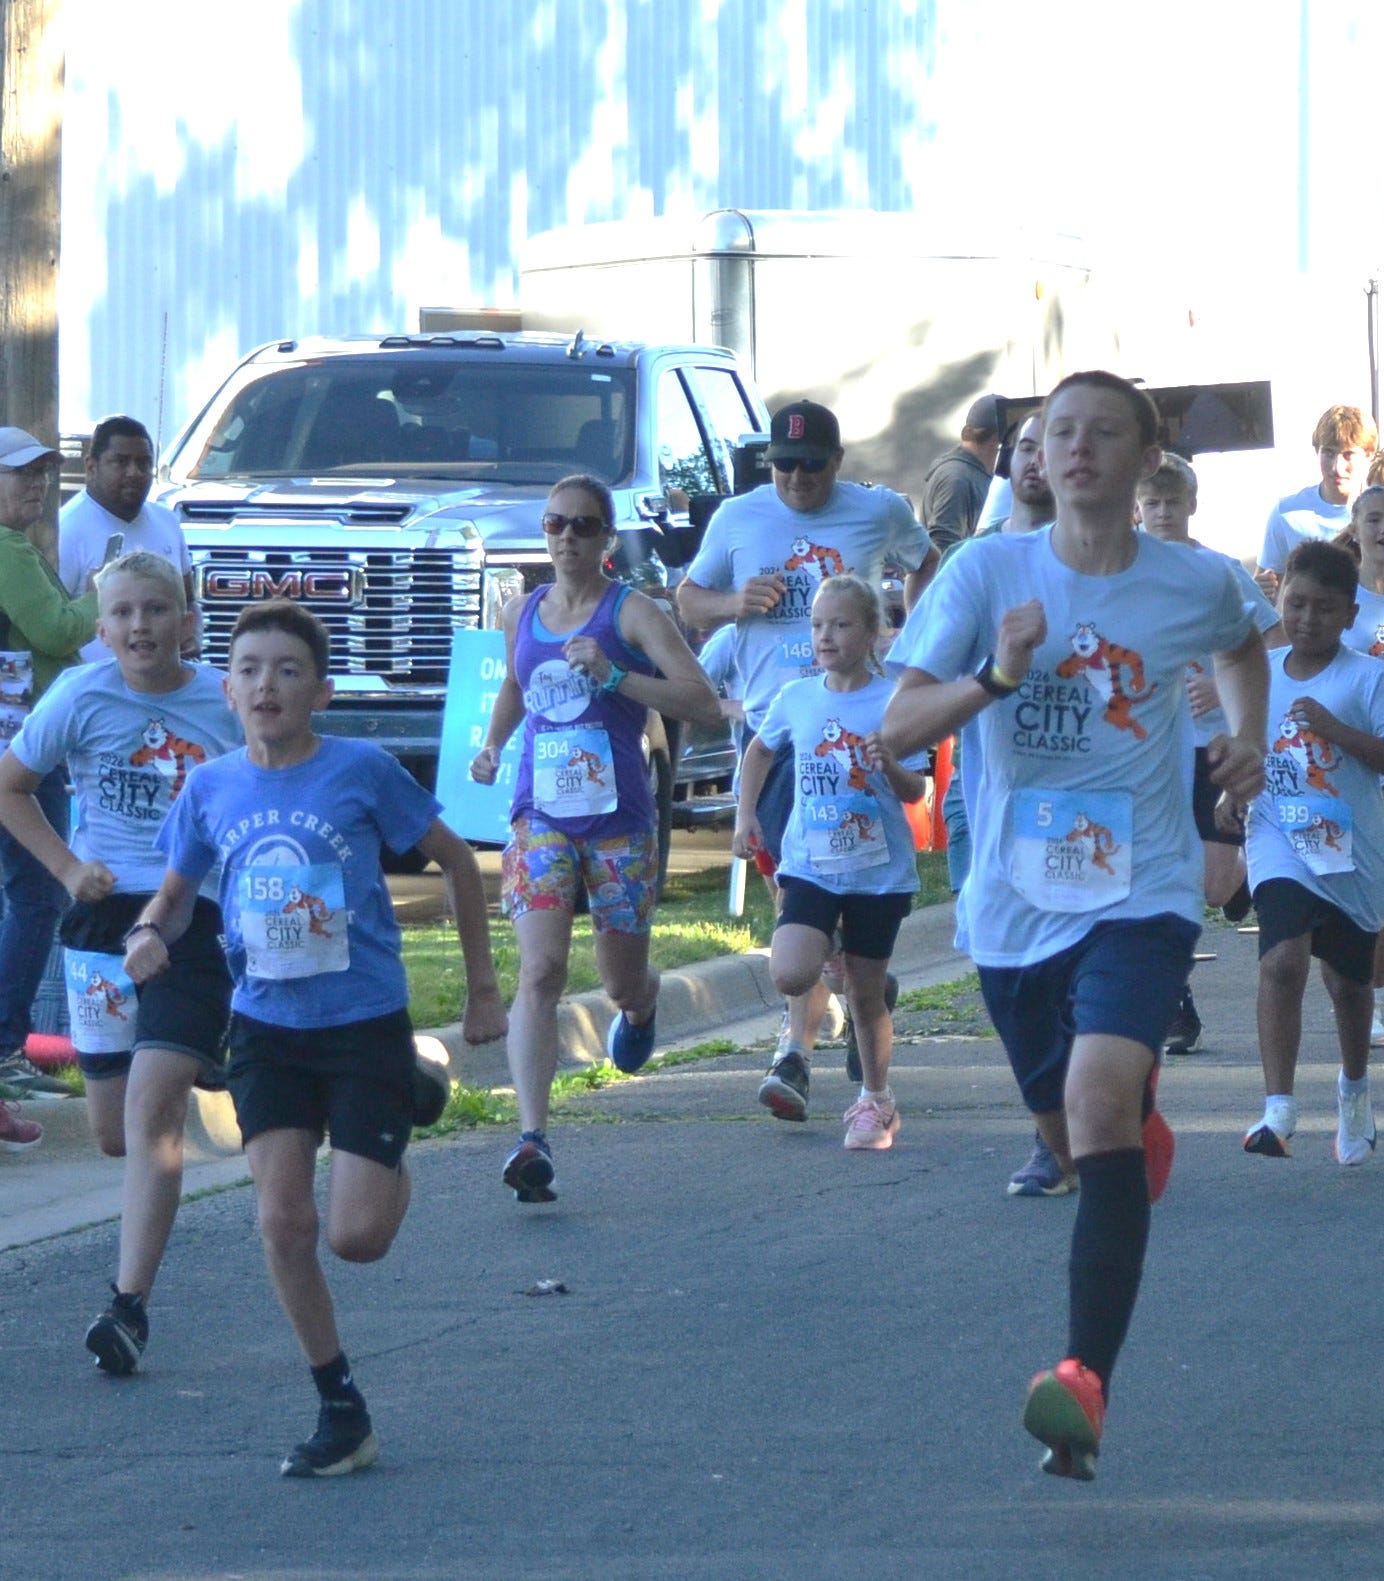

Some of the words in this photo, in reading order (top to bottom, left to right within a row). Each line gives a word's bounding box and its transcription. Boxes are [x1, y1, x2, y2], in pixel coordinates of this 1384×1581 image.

[207, 571, 350, 598] GMC
[781, 587, 811, 607] ITY
[782, 643, 812, 659] 146
[1027, 670, 1050, 682] 026
[1018, 683, 1093, 704] CEREAL
[1015, 702, 1092, 735] CITY
[537, 741, 570, 759] 304
[1013, 731, 1091, 753] CLASSIC
[800, 762, 840, 775] CEREAL
[1265, 756, 1298, 772] EREAL
[99, 764, 160, 784] CEREAL
[556, 777, 584, 788] CITY
[98, 777, 160, 807] CITY
[801, 776, 840, 796] CITY
[100, 797, 161, 821] CLASSIC
[811, 804, 838, 821] 143
[1037, 802, 1053, 827] 5
[1279, 804, 1309, 823] 339
[219, 809, 280, 860] ARPER
[290, 811, 353, 863] CREEK
[829, 837, 856, 849] CITY
[1046, 845, 1085, 855] CEREAL
[1295, 841, 1320, 850] CITY
[1045, 856, 1084, 871] CITY
[245, 877, 284, 900] 158
[266, 926, 303, 940] CITY
[77, 1005, 101, 1019] CITY
